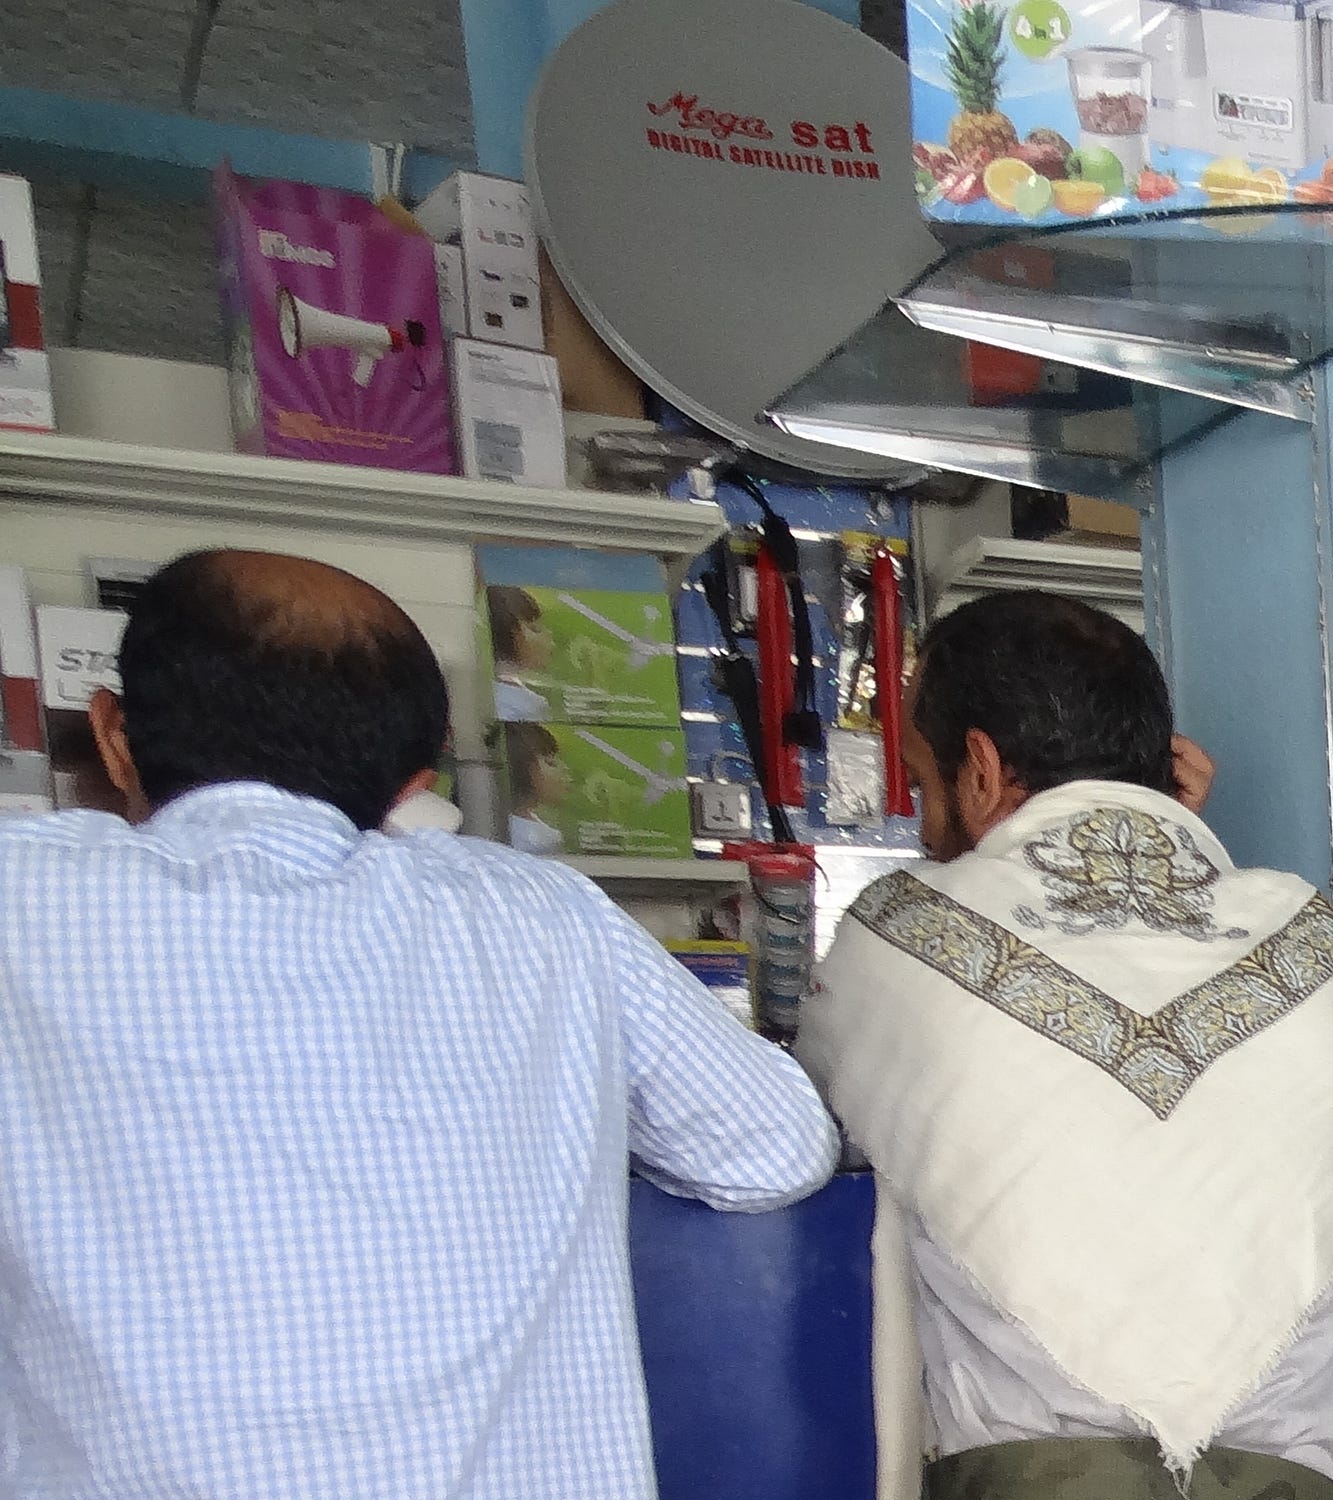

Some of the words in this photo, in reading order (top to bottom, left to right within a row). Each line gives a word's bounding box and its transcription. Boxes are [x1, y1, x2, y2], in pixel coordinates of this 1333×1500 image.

[646, 90, 774, 141] Mega
[790, 119, 874, 154] sat
[646, 127, 725, 162] DIGITAL
[728, 143, 827, 175] SATELLITE
